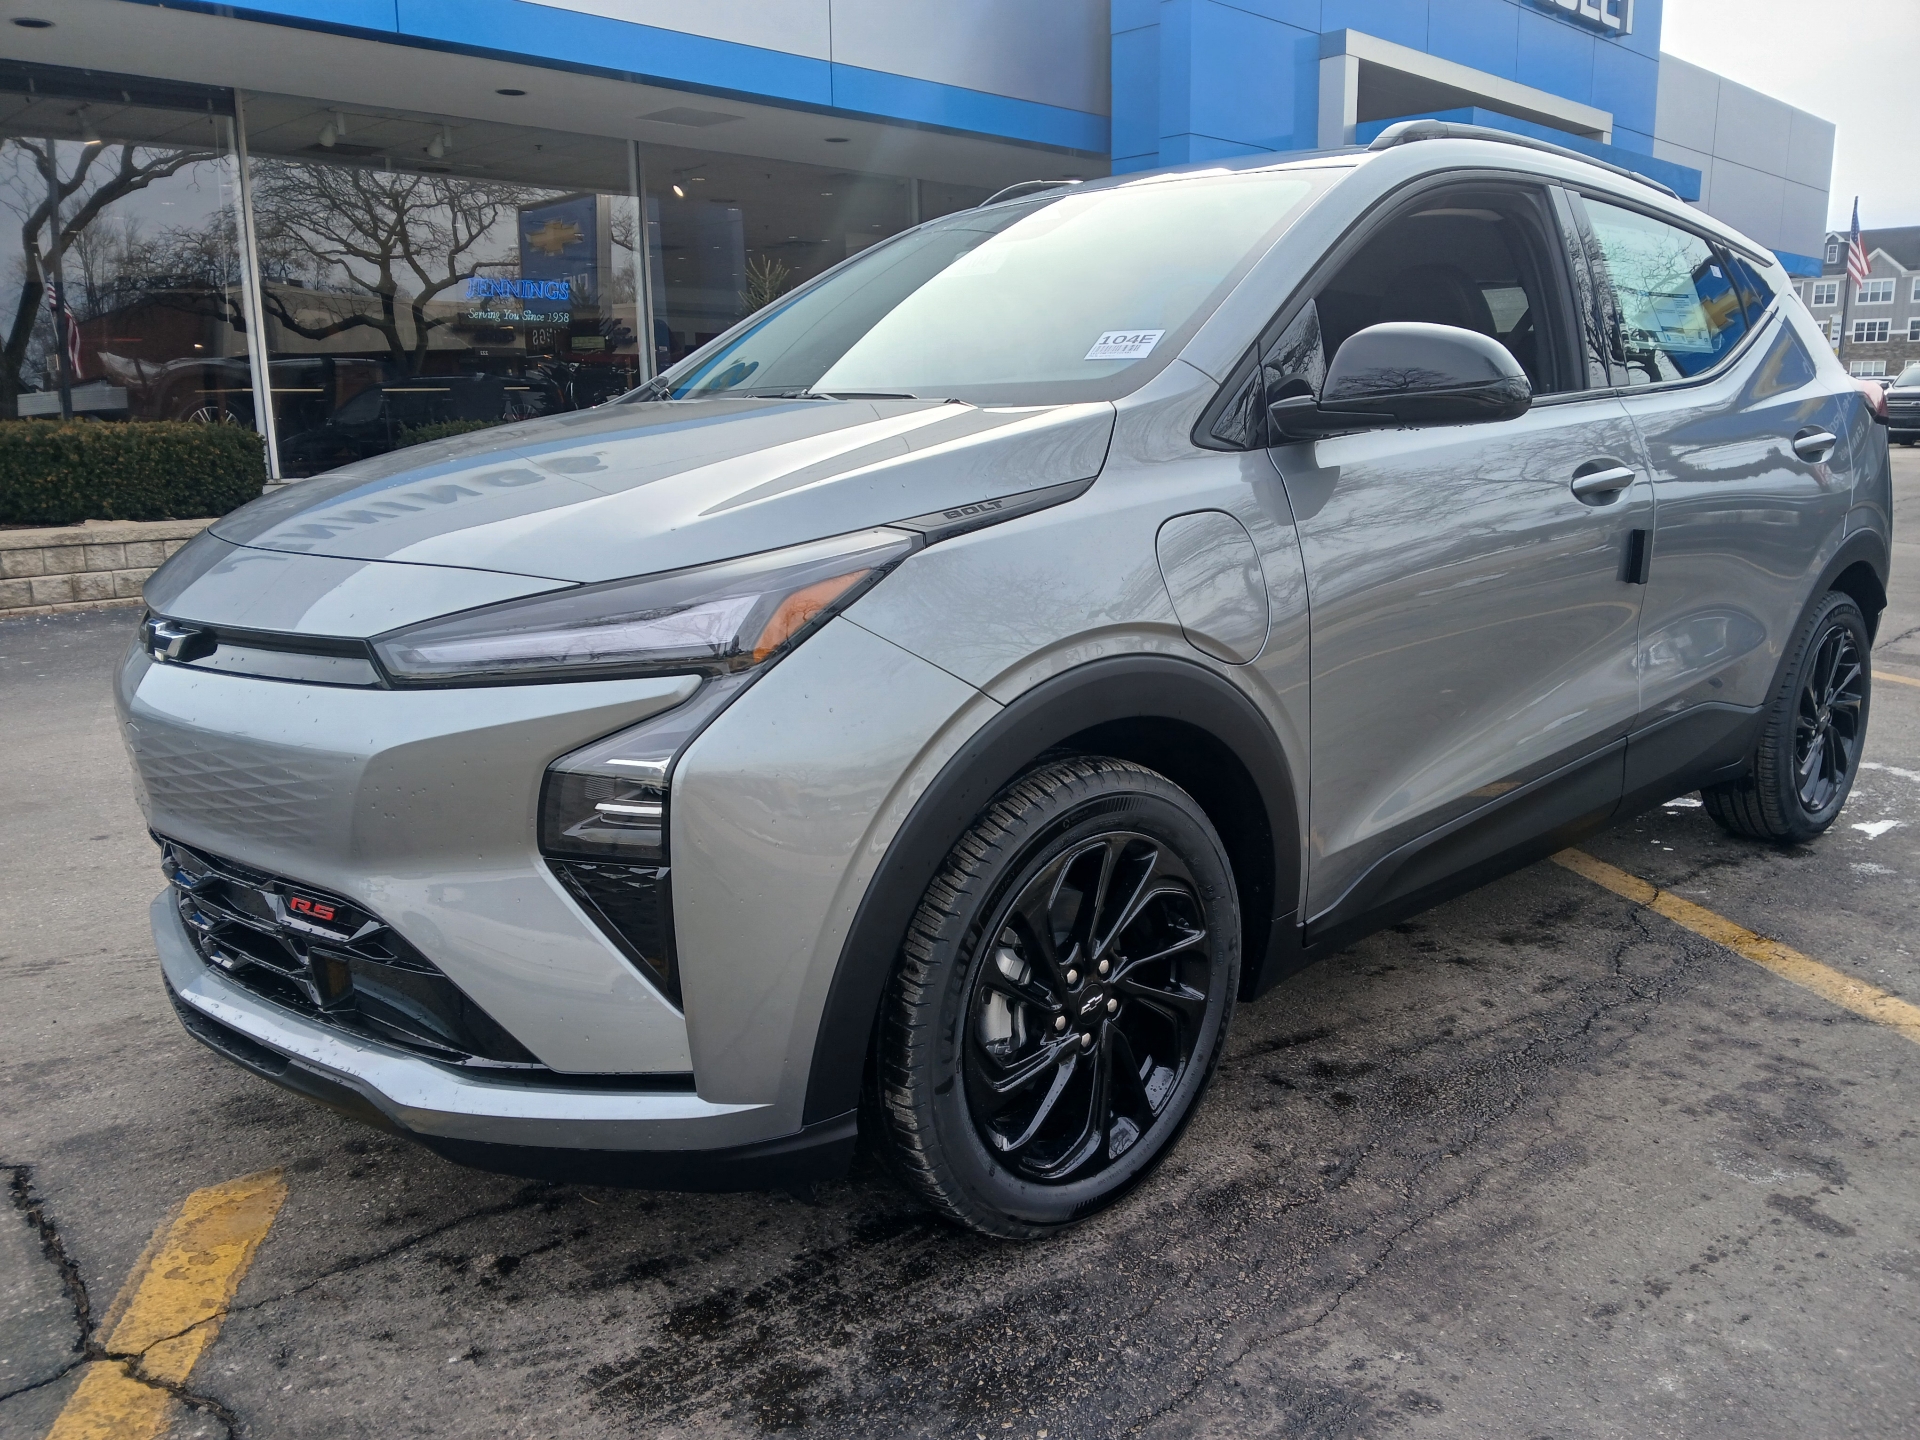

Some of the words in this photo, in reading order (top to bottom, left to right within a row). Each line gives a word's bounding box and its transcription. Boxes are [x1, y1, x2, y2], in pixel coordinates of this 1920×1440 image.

[465, 277, 570, 300] JENNINGS
[468, 307, 500, 322] Serving
[503, 309, 519, 320] You
[522, 310, 545, 321] Since
[547, 312, 570, 323] 1958
[1098, 334, 1156, 346] 104E
[942, 500, 1003, 520] BOLT
[290, 897, 335, 920] RS
